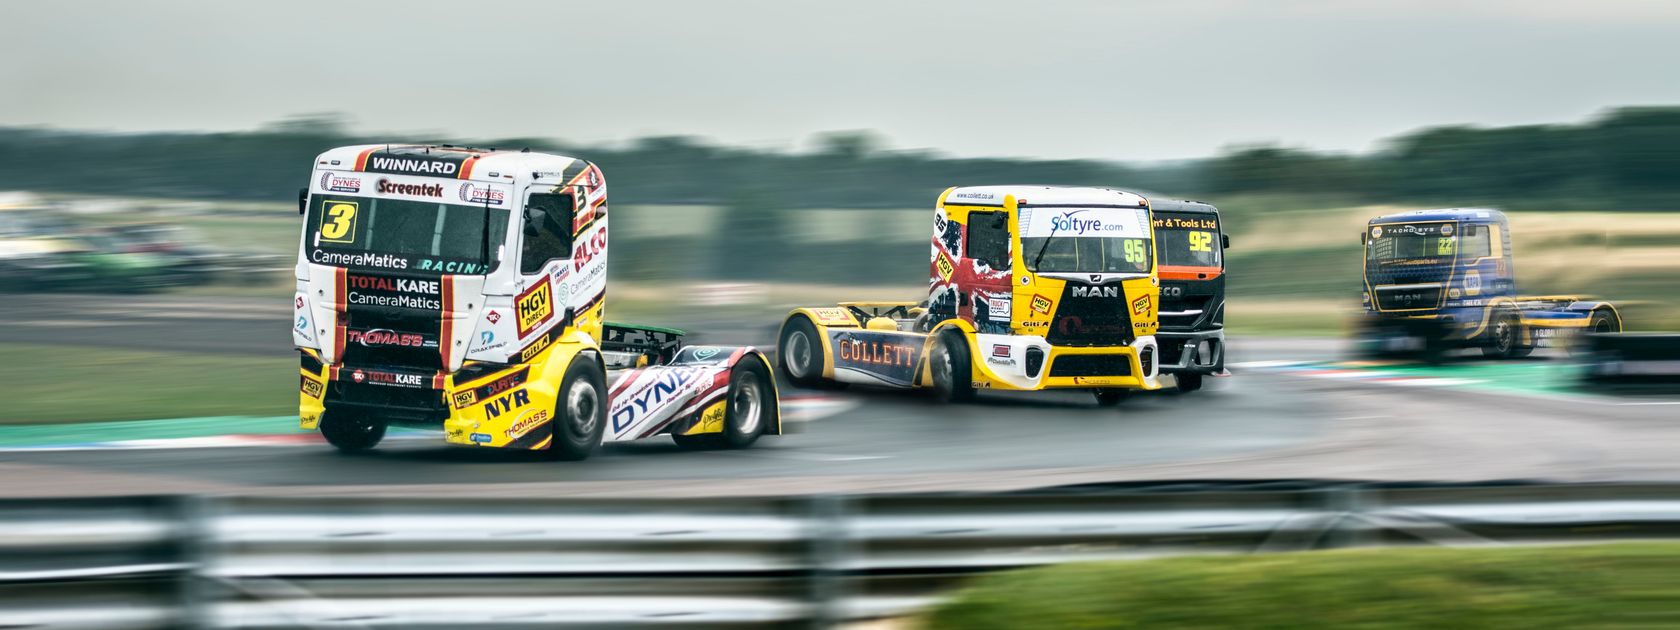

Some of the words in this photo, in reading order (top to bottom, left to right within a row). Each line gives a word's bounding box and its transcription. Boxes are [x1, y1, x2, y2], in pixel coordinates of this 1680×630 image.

[373, 157, 457, 174] WINNARD
[332, 179, 361, 188] DYNES
[378, 178, 444, 198] Screentek
[472, 190, 505, 200] DYNES
[321, 204, 355, 239] 3
[1165, 218, 1173, 227] &
[1174, 218, 1199, 227] Tools
[1201, 219, 1216, 228] Ltd
[1189, 230, 1212, 252] 92
[1439, 239, 1452, 248] 22
[312, 249, 408, 269] CameraMatics
[574, 227, 607, 274] ALCO
[1123, 239, 1144, 263] 95
[939, 253, 953, 274] HGV
[350, 275, 439, 294] TOTALKARE
[1072, 286, 1118, 298] MAN
[348, 292, 441, 310] CameraMatics
[520, 286, 546, 319] HGV
[1034, 297, 1049, 308] HGV
[1135, 298, 1148, 308] HGV
[526, 307, 545, 326] DIRECT
[523, 344, 540, 359] Giti
[839, 340, 915, 367] COLLETT
[304, 380, 319, 392] HGV
[368, 371, 422, 385] TOTALKARE
[456, 391, 473, 403] HGV
[484, 388, 530, 420] NYR
